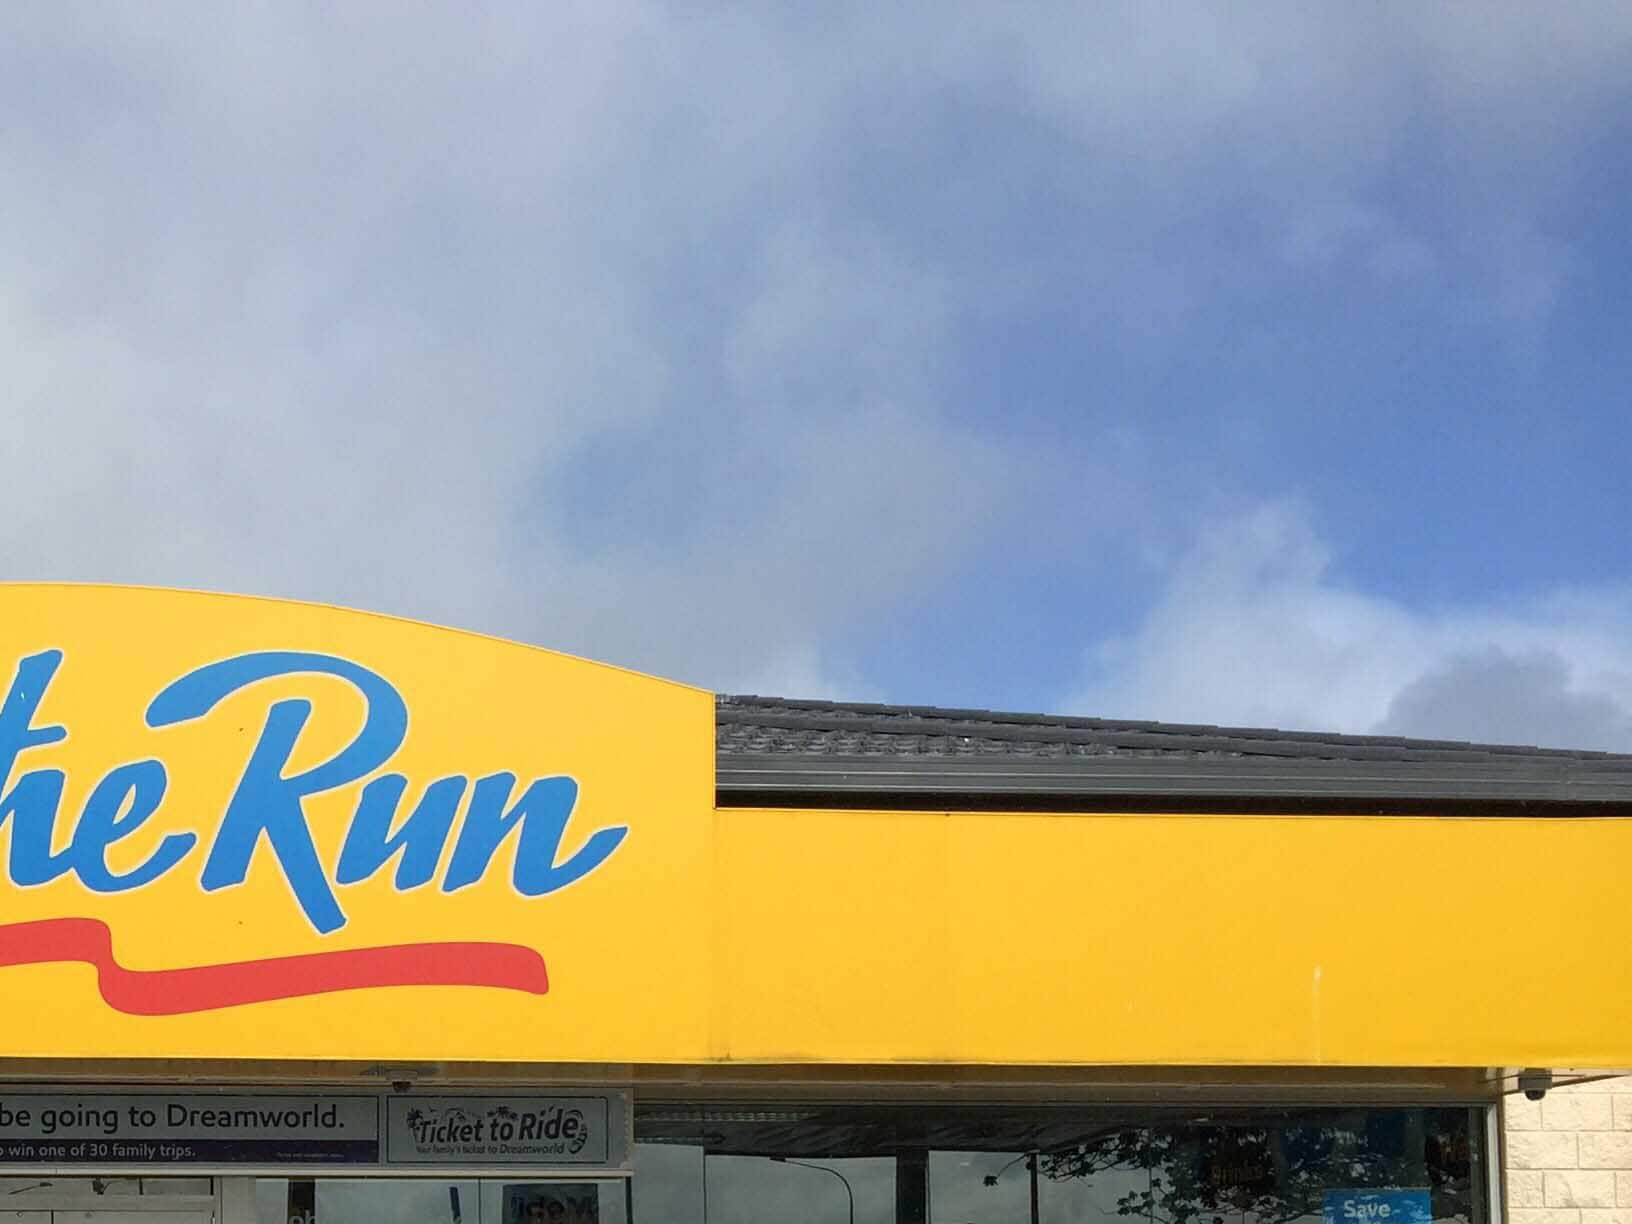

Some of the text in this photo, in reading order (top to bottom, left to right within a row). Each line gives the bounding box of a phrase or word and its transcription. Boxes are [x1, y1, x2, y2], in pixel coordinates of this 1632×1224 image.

[142, 648, 629, 935] Run
[40, 1104, 119, 1134] going
[128, 1106, 157, 1128] to
[167, 1103, 345, 1129] Dreamworld.
[415, 1107, 579, 1144] Ticket to Ride
[8, 1144, 34, 1157] win
[38, 1147, 66, 1157] one
[70, 1143, 87, 1157] of
[89, 1144, 108, 1157] 30
[112, 1143, 156, 1160] family
[159, 1144, 196, 1160] trips.
[498, 1143, 565, 1154] Dreamworld
[1343, 1200, 1391, 1218] Save
